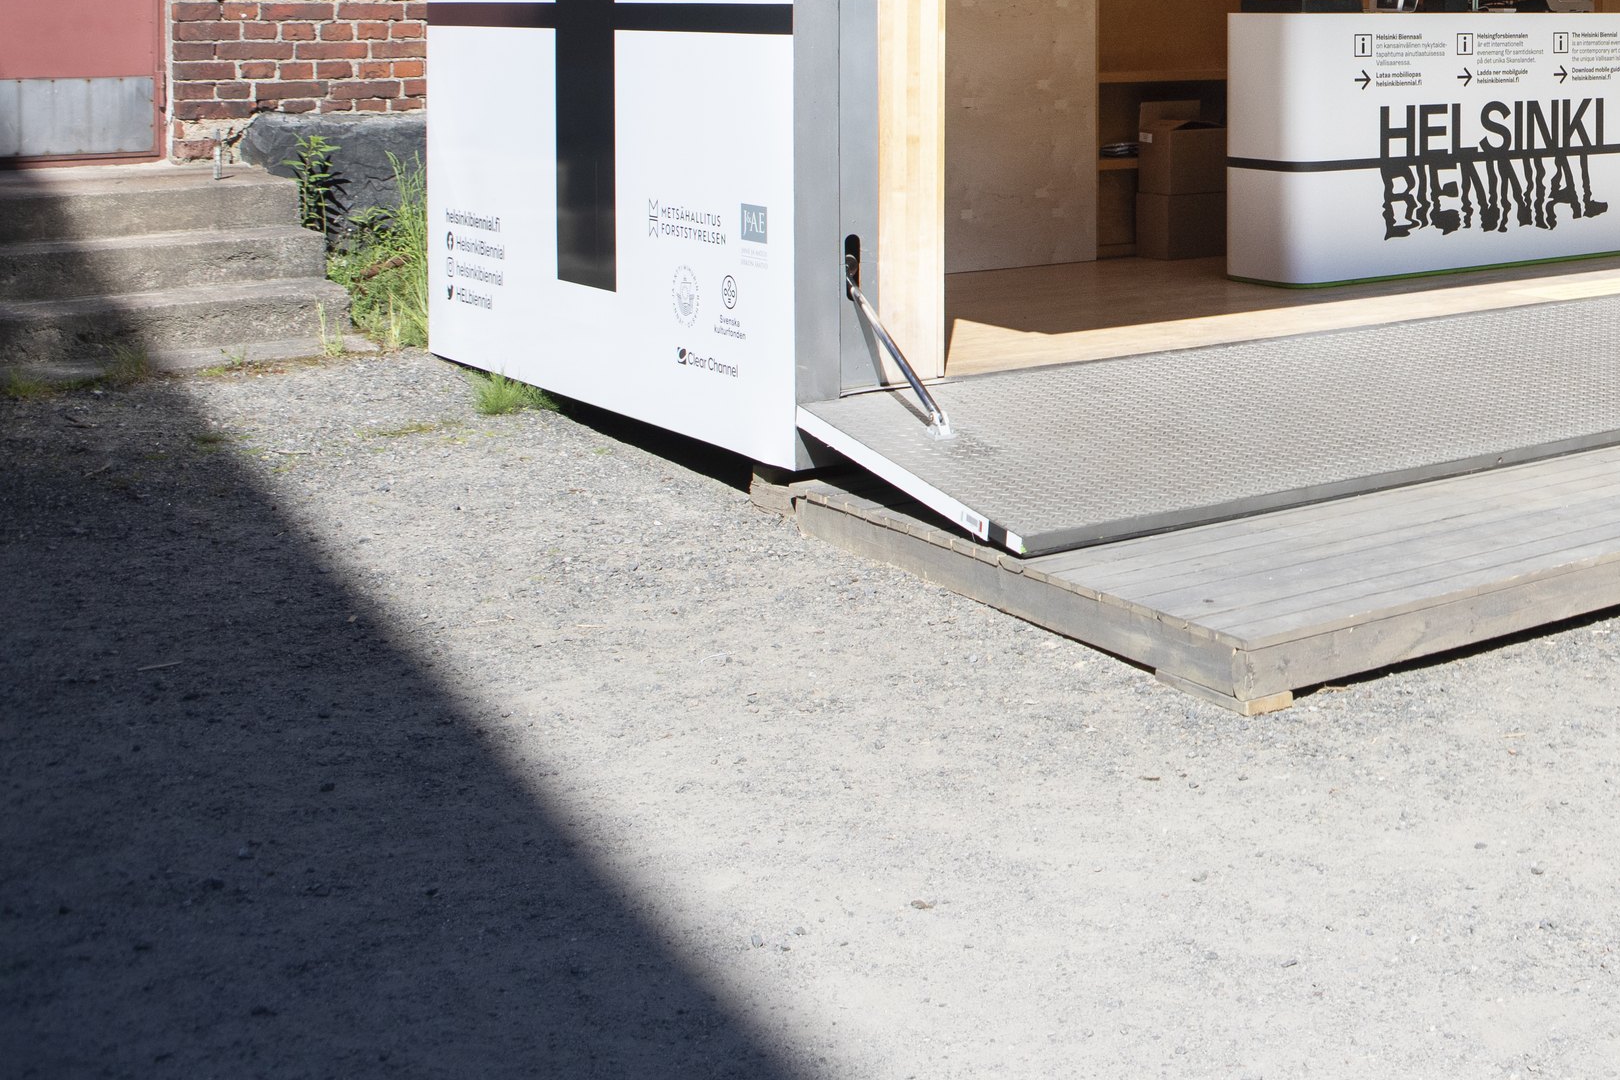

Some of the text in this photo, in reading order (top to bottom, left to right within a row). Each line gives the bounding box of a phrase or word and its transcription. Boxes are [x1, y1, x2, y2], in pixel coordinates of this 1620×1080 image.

[1379, 97, 1605, 160] HELSINKI
[1380, 152, 1609, 240] BIENNIAL
[446, 208, 501, 232] helsinkibiennial.fi
[661, 206, 721, 227] METSÄHALLITUS
[661, 223, 727, 245] FORSTSTYRELSEN
[456, 236, 505, 260] HelsinkiBiennial
[456, 260, 504, 286] helsinkibiennial
[456, 286, 493, 310] HELbiennial
[714, 324, 747, 341] kulturfonden
[719, 314, 741, 328] Svenska
[688, 351, 739, 378] Clear Channel
